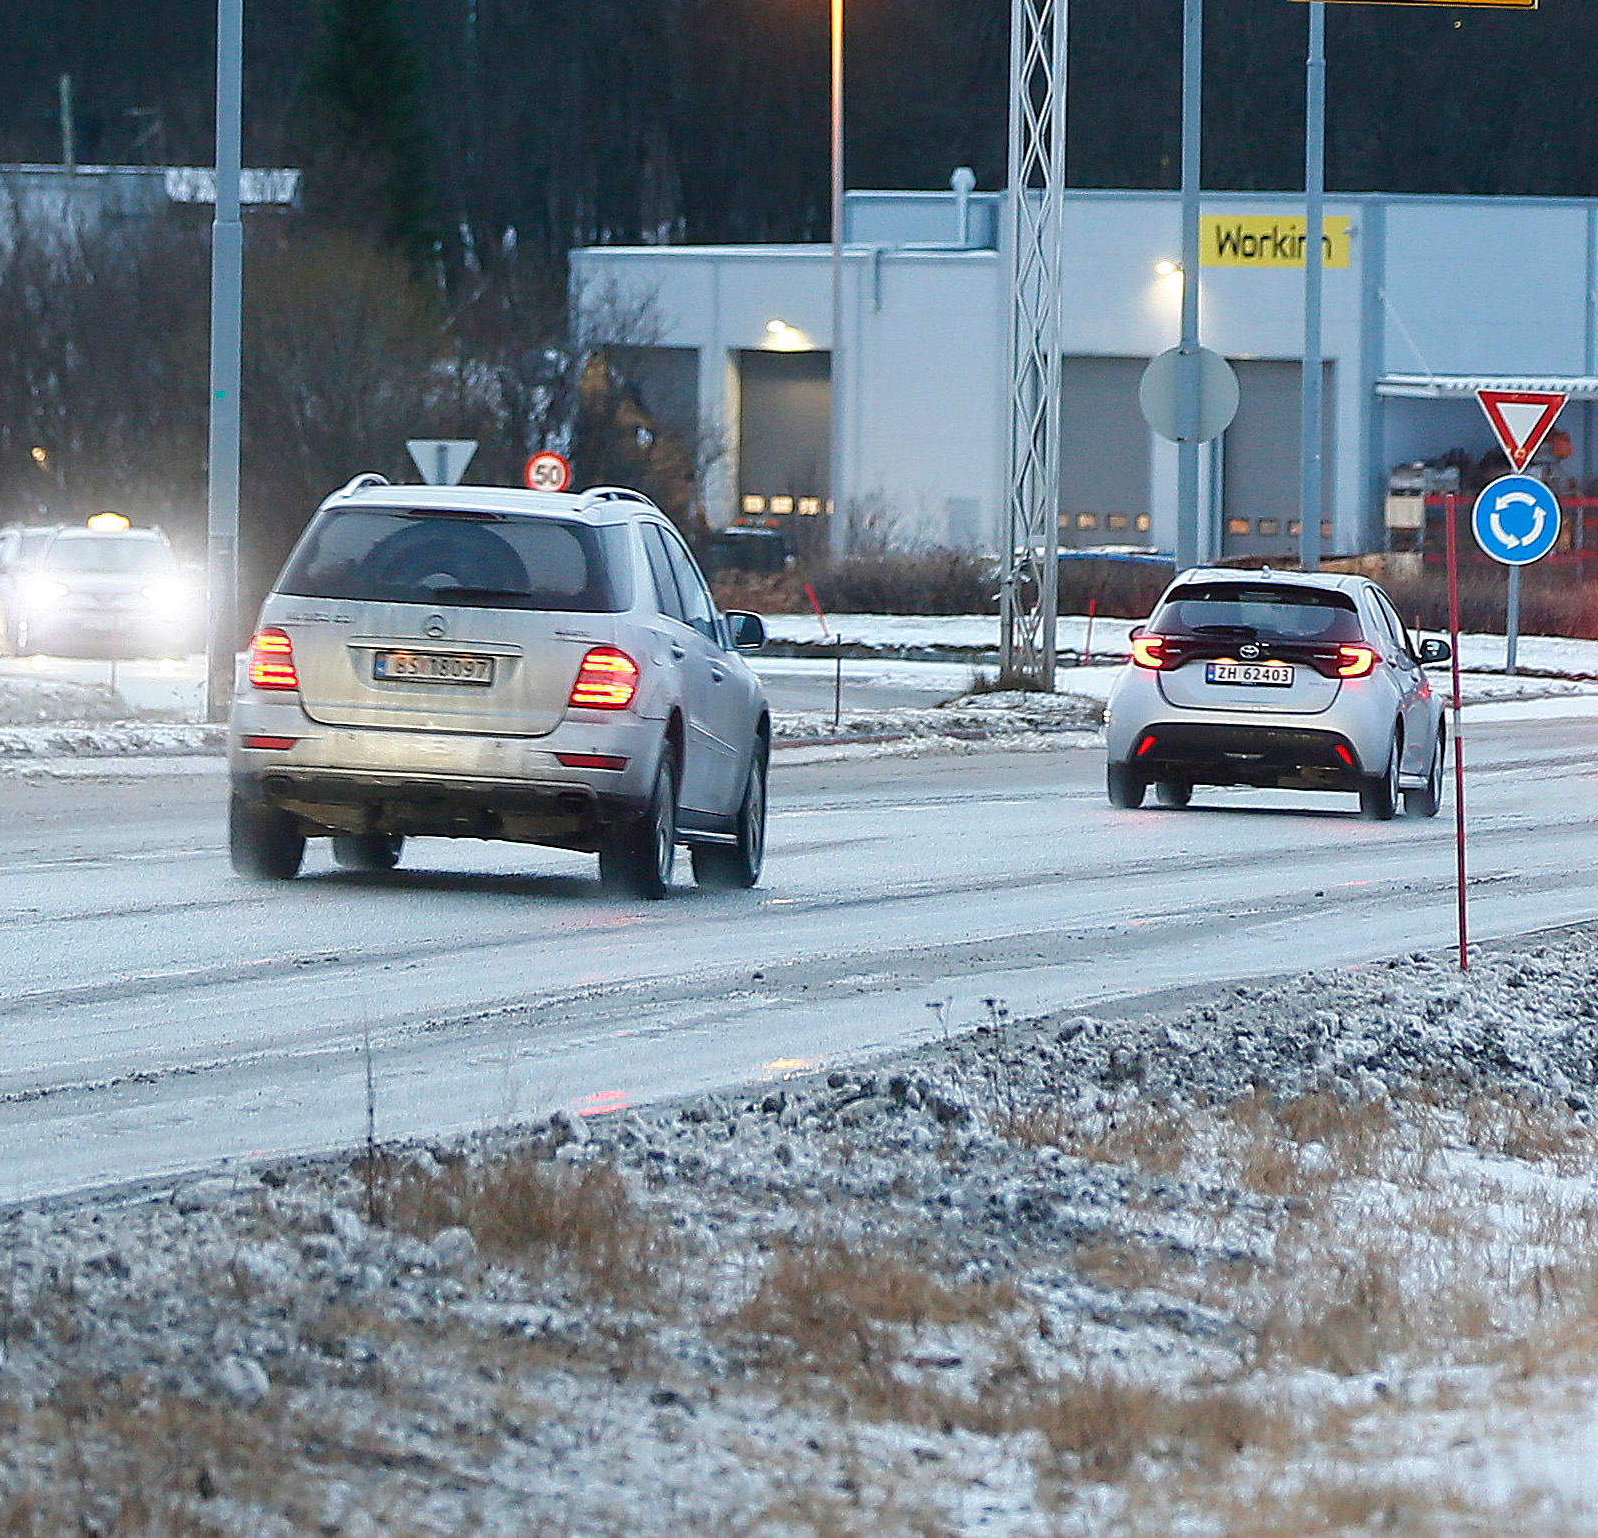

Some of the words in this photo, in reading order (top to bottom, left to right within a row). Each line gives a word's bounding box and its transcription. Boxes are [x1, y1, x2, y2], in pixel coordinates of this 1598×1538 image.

[534, 464, 562, 485] 50
[1218, 667, 1237, 680] ZH
[1243, 668, 1289, 681] 62403
